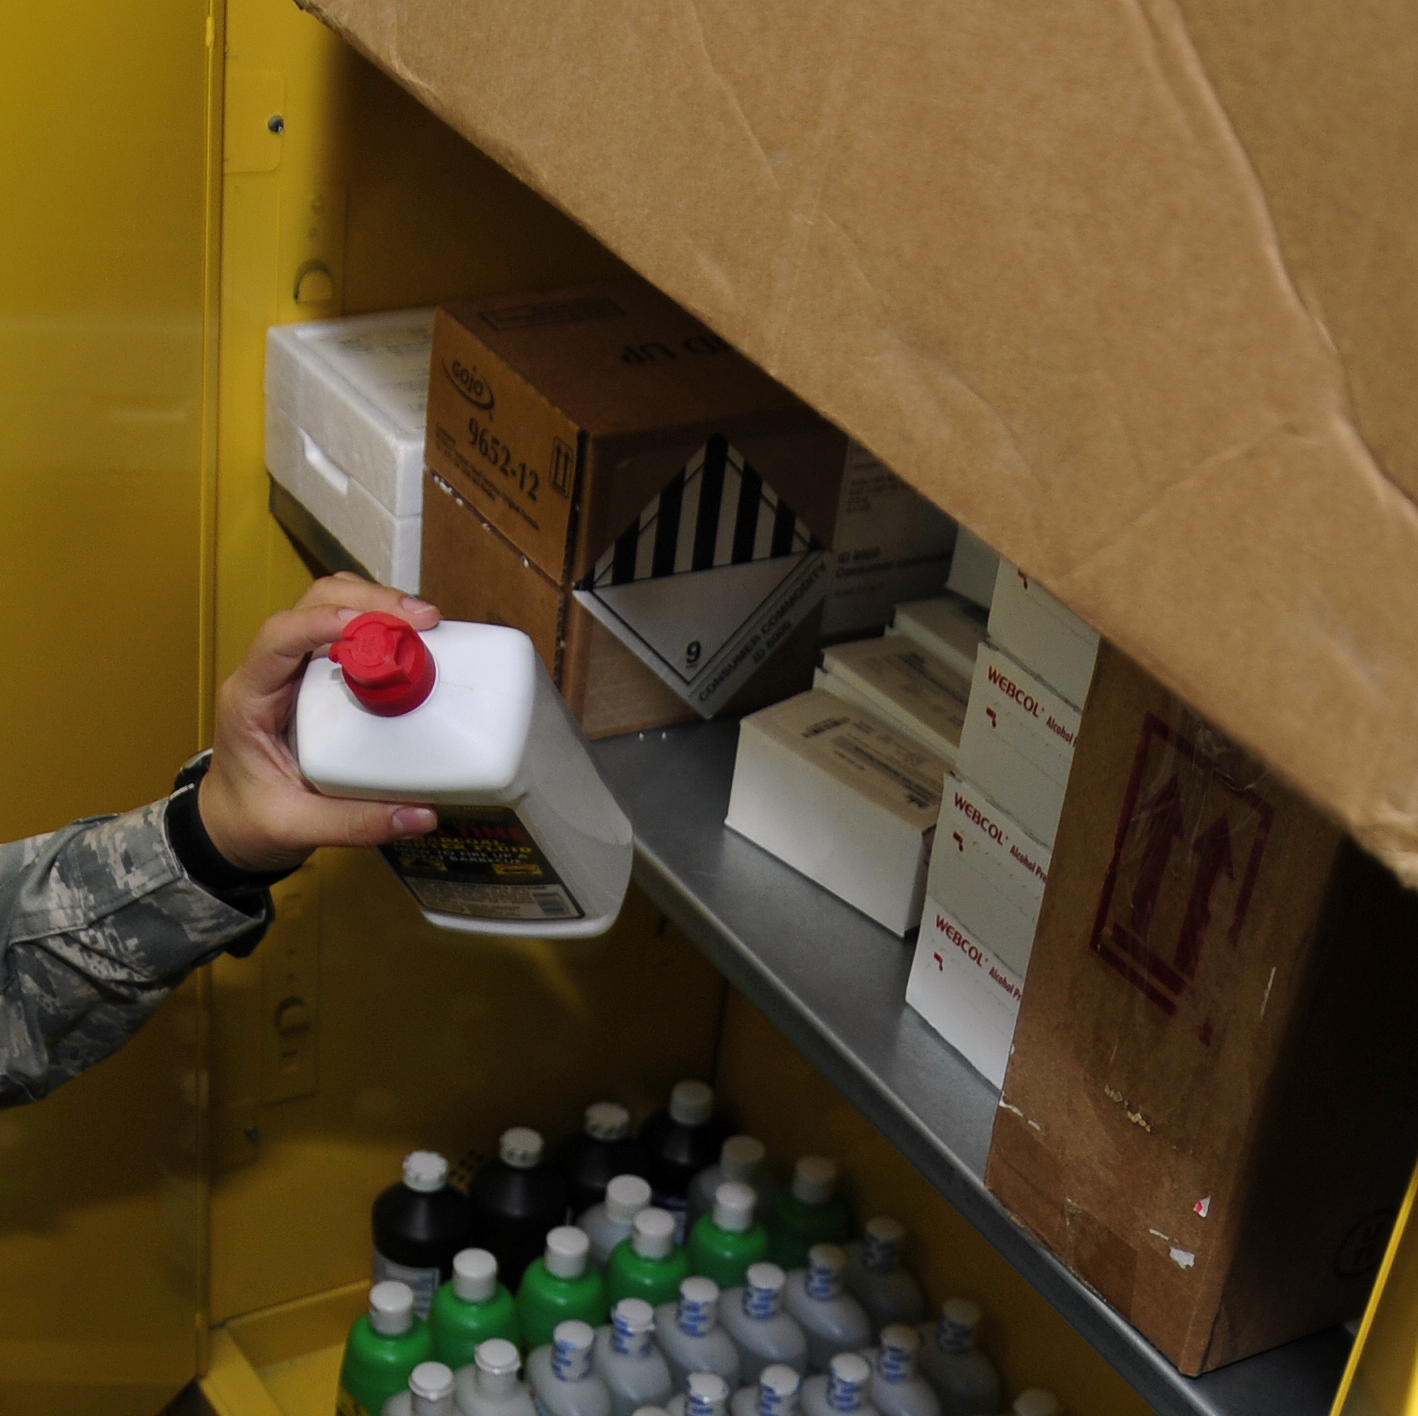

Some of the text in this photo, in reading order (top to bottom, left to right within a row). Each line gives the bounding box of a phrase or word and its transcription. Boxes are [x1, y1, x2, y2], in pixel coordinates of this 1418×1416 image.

[468, 417, 541, 501] 9652-12
[686, 641, 701, 664] 9
[695, 632, 763, 702] CONSUMER
